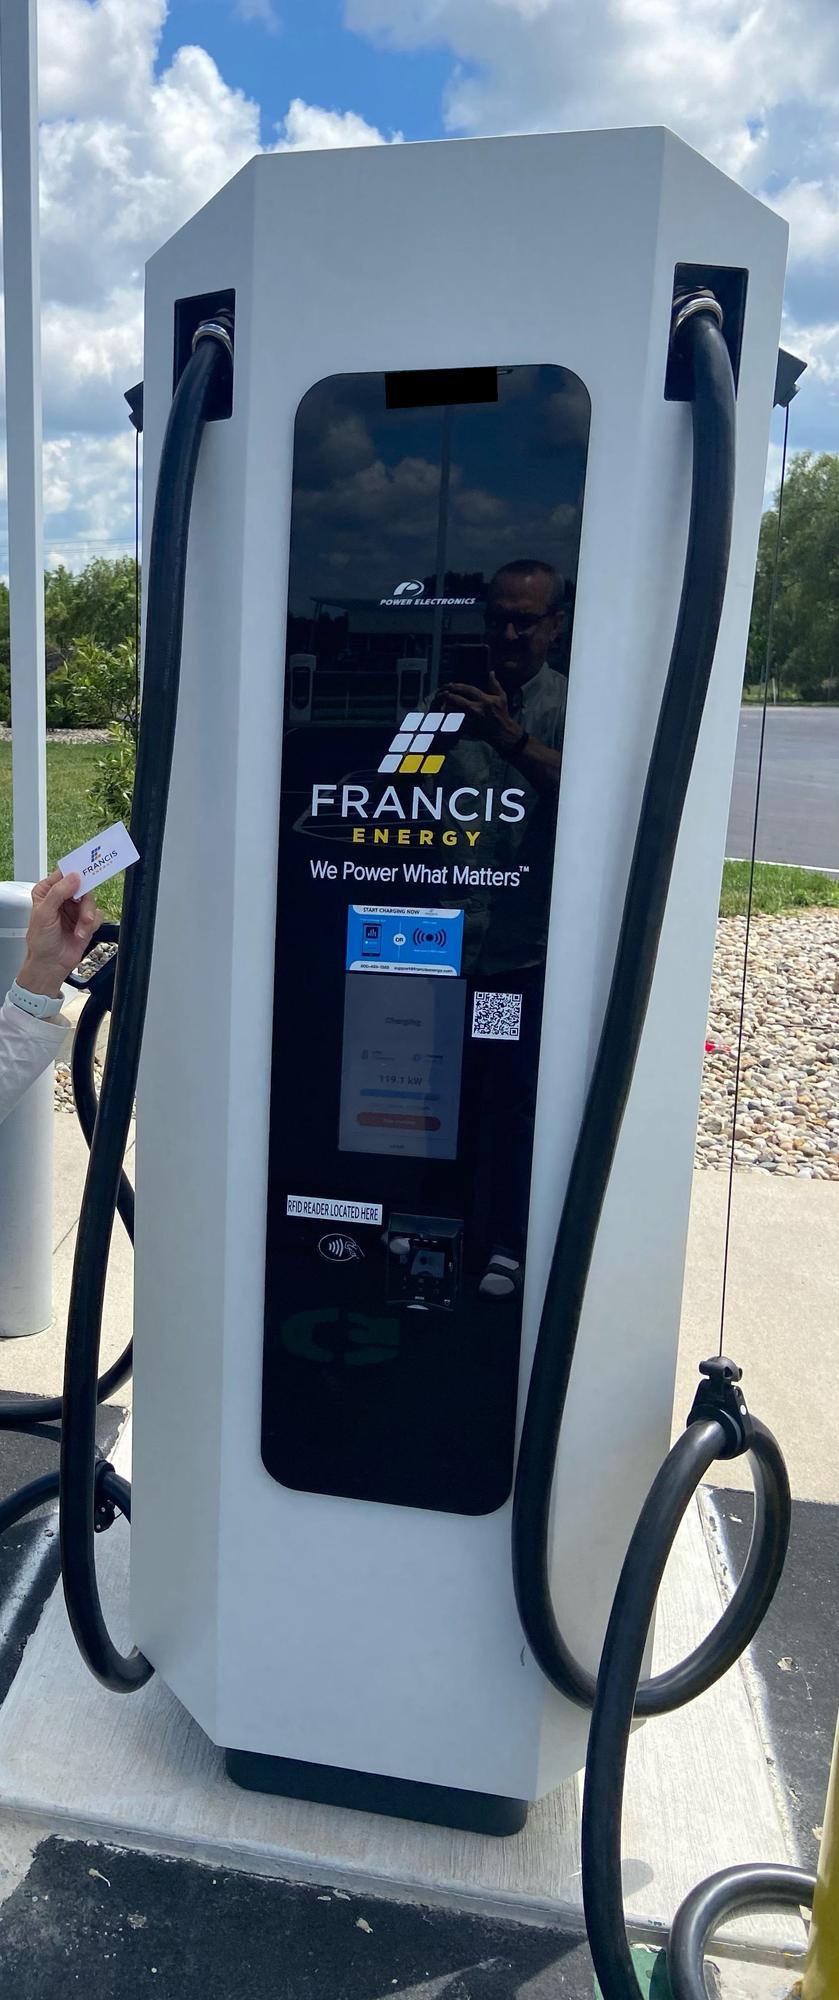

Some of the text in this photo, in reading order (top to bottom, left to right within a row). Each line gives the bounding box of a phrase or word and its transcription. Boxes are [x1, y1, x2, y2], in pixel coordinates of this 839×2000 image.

[379, 597, 477, 606] POWER ELECTRONICS
[311, 783, 526, 823] FRANCIS
[352, 827, 481, 847] ENERGY
[82, 850, 118, 876] FRANCIS
[309, 860, 338, 880] We
[342, 861, 399, 882] Power
[402, 863, 448, 885] What
[385, 1016, 422, 1027] Charging
[407, 1076, 423, 1086] kW
[288, 1199, 379, 1221] RFID READER LOCATED HERE
